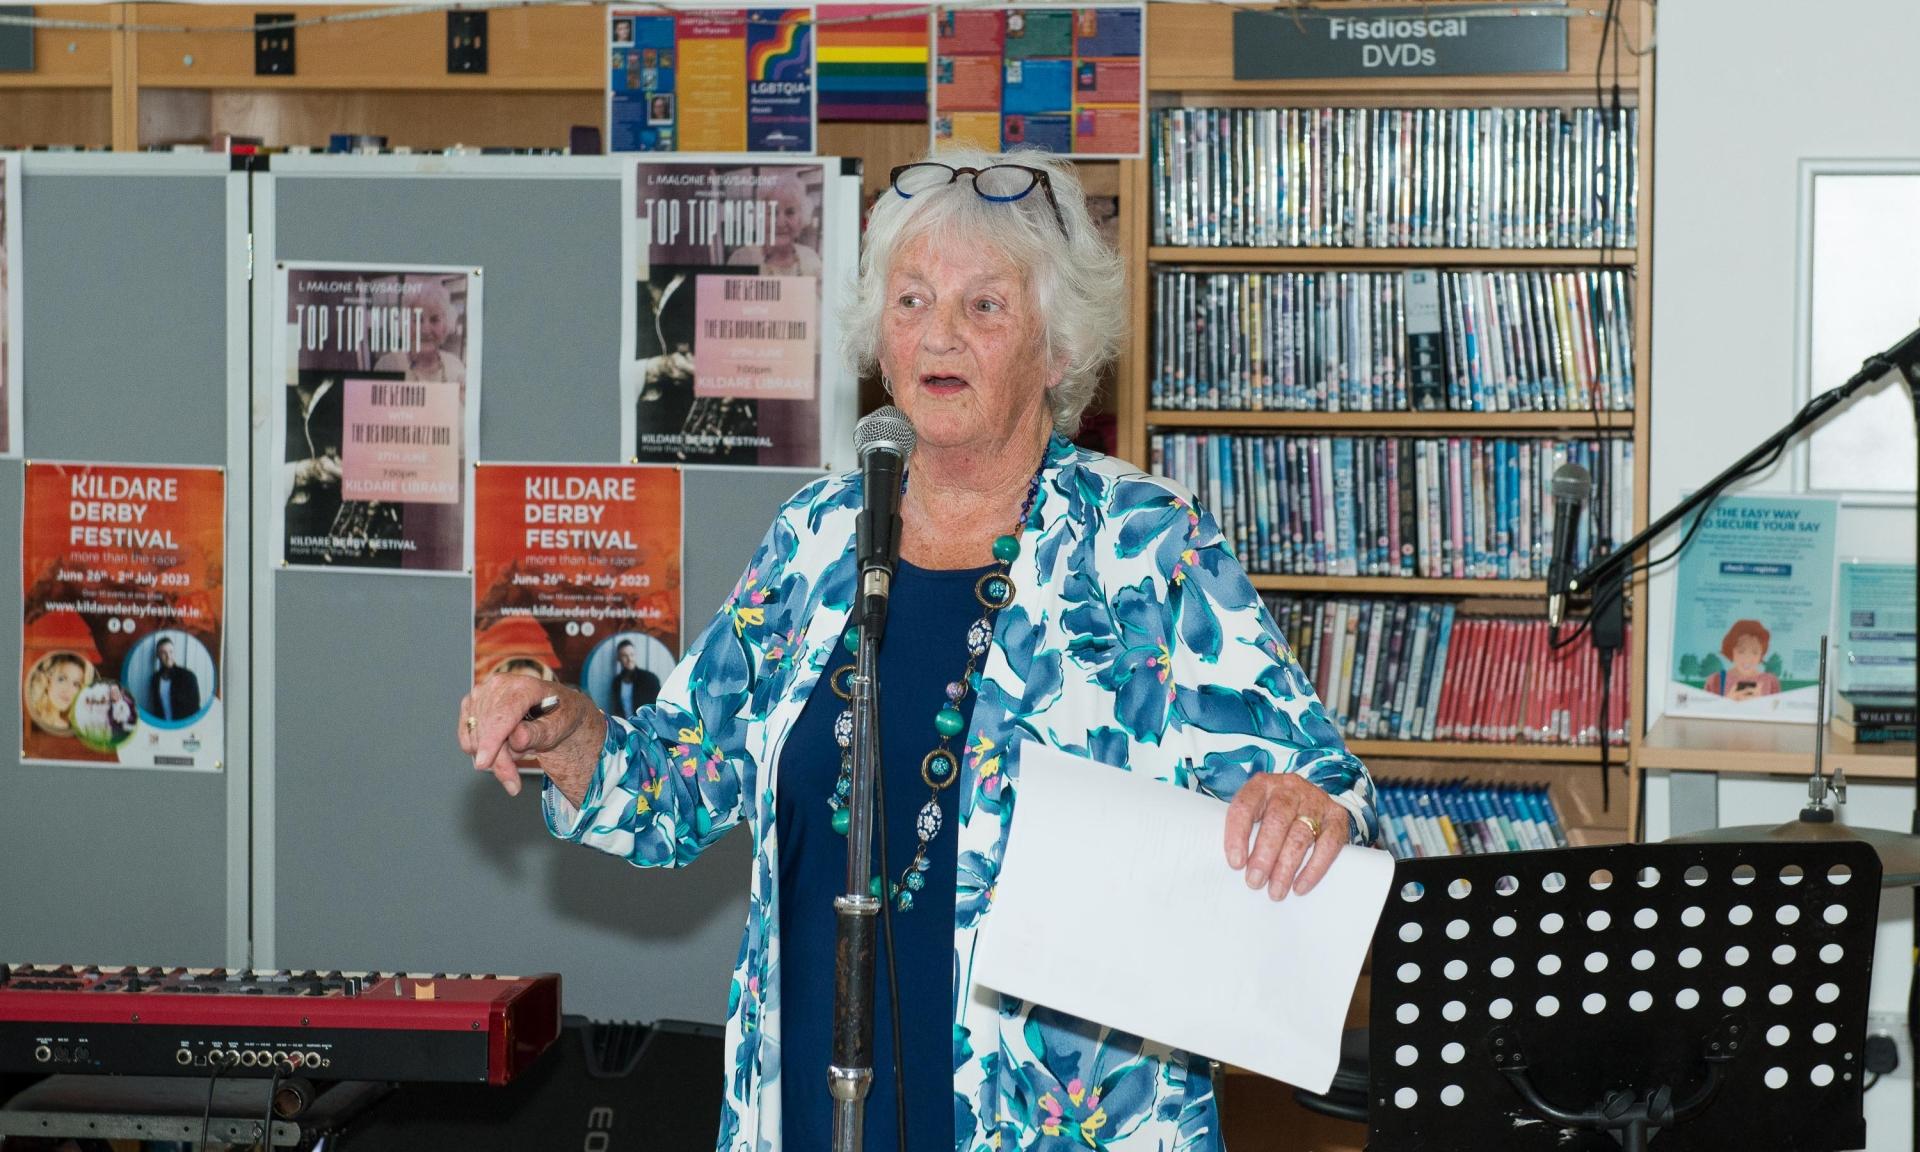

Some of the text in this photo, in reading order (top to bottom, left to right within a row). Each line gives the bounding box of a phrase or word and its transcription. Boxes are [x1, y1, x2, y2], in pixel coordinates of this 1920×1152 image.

[1361, 43, 1437, 67] DVDs
[655, 174, 705, 186] MALONE
[707, 175, 778, 187] NEWSAGENT
[645, 199, 779, 247] TOP TIP NIGHT
[306, 280, 353, 294] MALONE
[355, 281, 423, 295] NEWSAGENT
[296, 304, 423, 353] TOP TIP NIGHT
[698, 376, 810, 391] KILDARE LIBRARY
[412, 425, 431, 446] JAZZ
[641, 433, 773, 448] KILDARE DERBY FESTIVAL
[70, 474, 178, 501] KILDARE
[345, 479, 456, 495] KILDARE LIBRARY
[525, 476, 637, 501] KILDARE
[69, 501, 148, 524] DERBY
[524, 503, 605, 524] DERBY
[1716, 507, 1801, 519] THE EASY WAY
[1717, 518, 1760, 531] SECURE
[1761, 520, 1796, 532] YOUR
[1798, 521, 1821, 533] SAY
[69, 526, 179, 550] FESTIVAL
[290, 535, 417, 551] KILDARE DERBY FESTIVAL
[525, 528, 639, 550] FESTIVAL
[70, 550, 177, 566] more than the race
[525, 553, 636, 567] more than the race
[56, 568, 84, 582] June
[86, 569, 108, 582] 26th
[135, 573, 158, 587] July
[161, 574, 191, 586] 2023
[512, 573, 540, 586] June
[543, 573, 566, 586] 26th
[593, 575, 617, 589] July
[620, 576, 650, 587] 2023
[45, 600, 202, 618] www.kildarederbyfestival.ie
[500, 605, 662, 620] www.kildarederbyfestival.ie
[1860, 711, 1890, 722] WHAT
